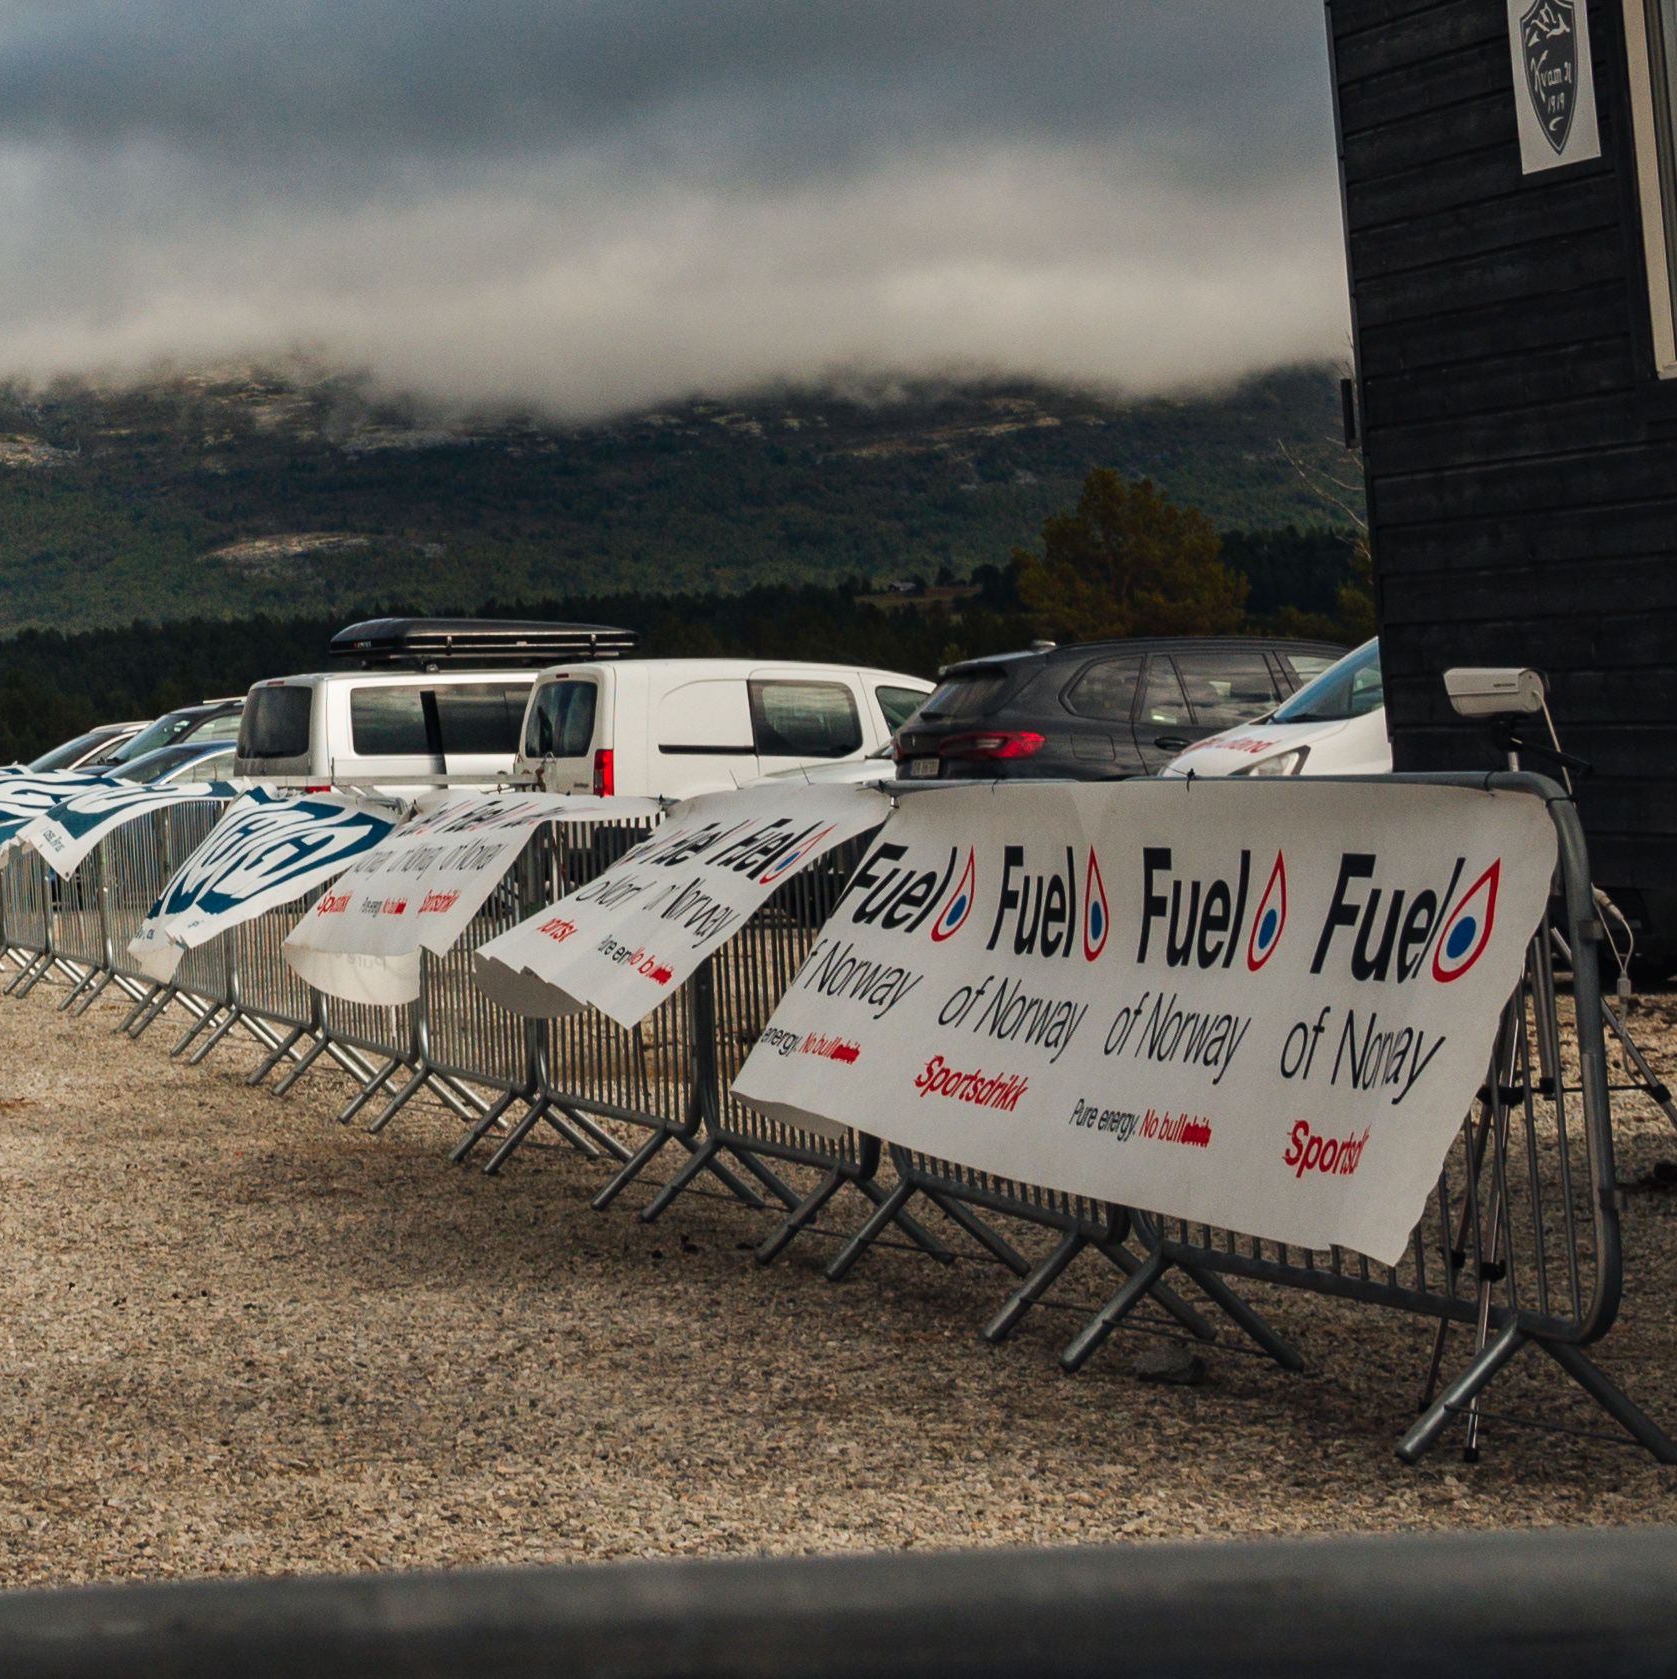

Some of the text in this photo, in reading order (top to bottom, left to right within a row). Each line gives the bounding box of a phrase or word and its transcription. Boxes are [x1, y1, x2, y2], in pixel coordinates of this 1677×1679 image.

[1547, 91, 1566, 114] 1919
[704, 818, 824, 880] Fuel
[828, 842, 958, 933] Fuel
[986, 845, 1076, 958] Fuel
[1137, 846, 1251, 969] Fuel
[1310, 852, 1467, 984] Fuel
[804, 940, 924, 1019] Norway
[938, 975, 1088, 1064] of Norway
[1104, 991, 1252, 1085] of Norway
[1280, 1006, 1331, 1080] of
[913, 1054, 1029, 1112] Sportsdrikk
[1139, 1108, 1160, 1139] No
